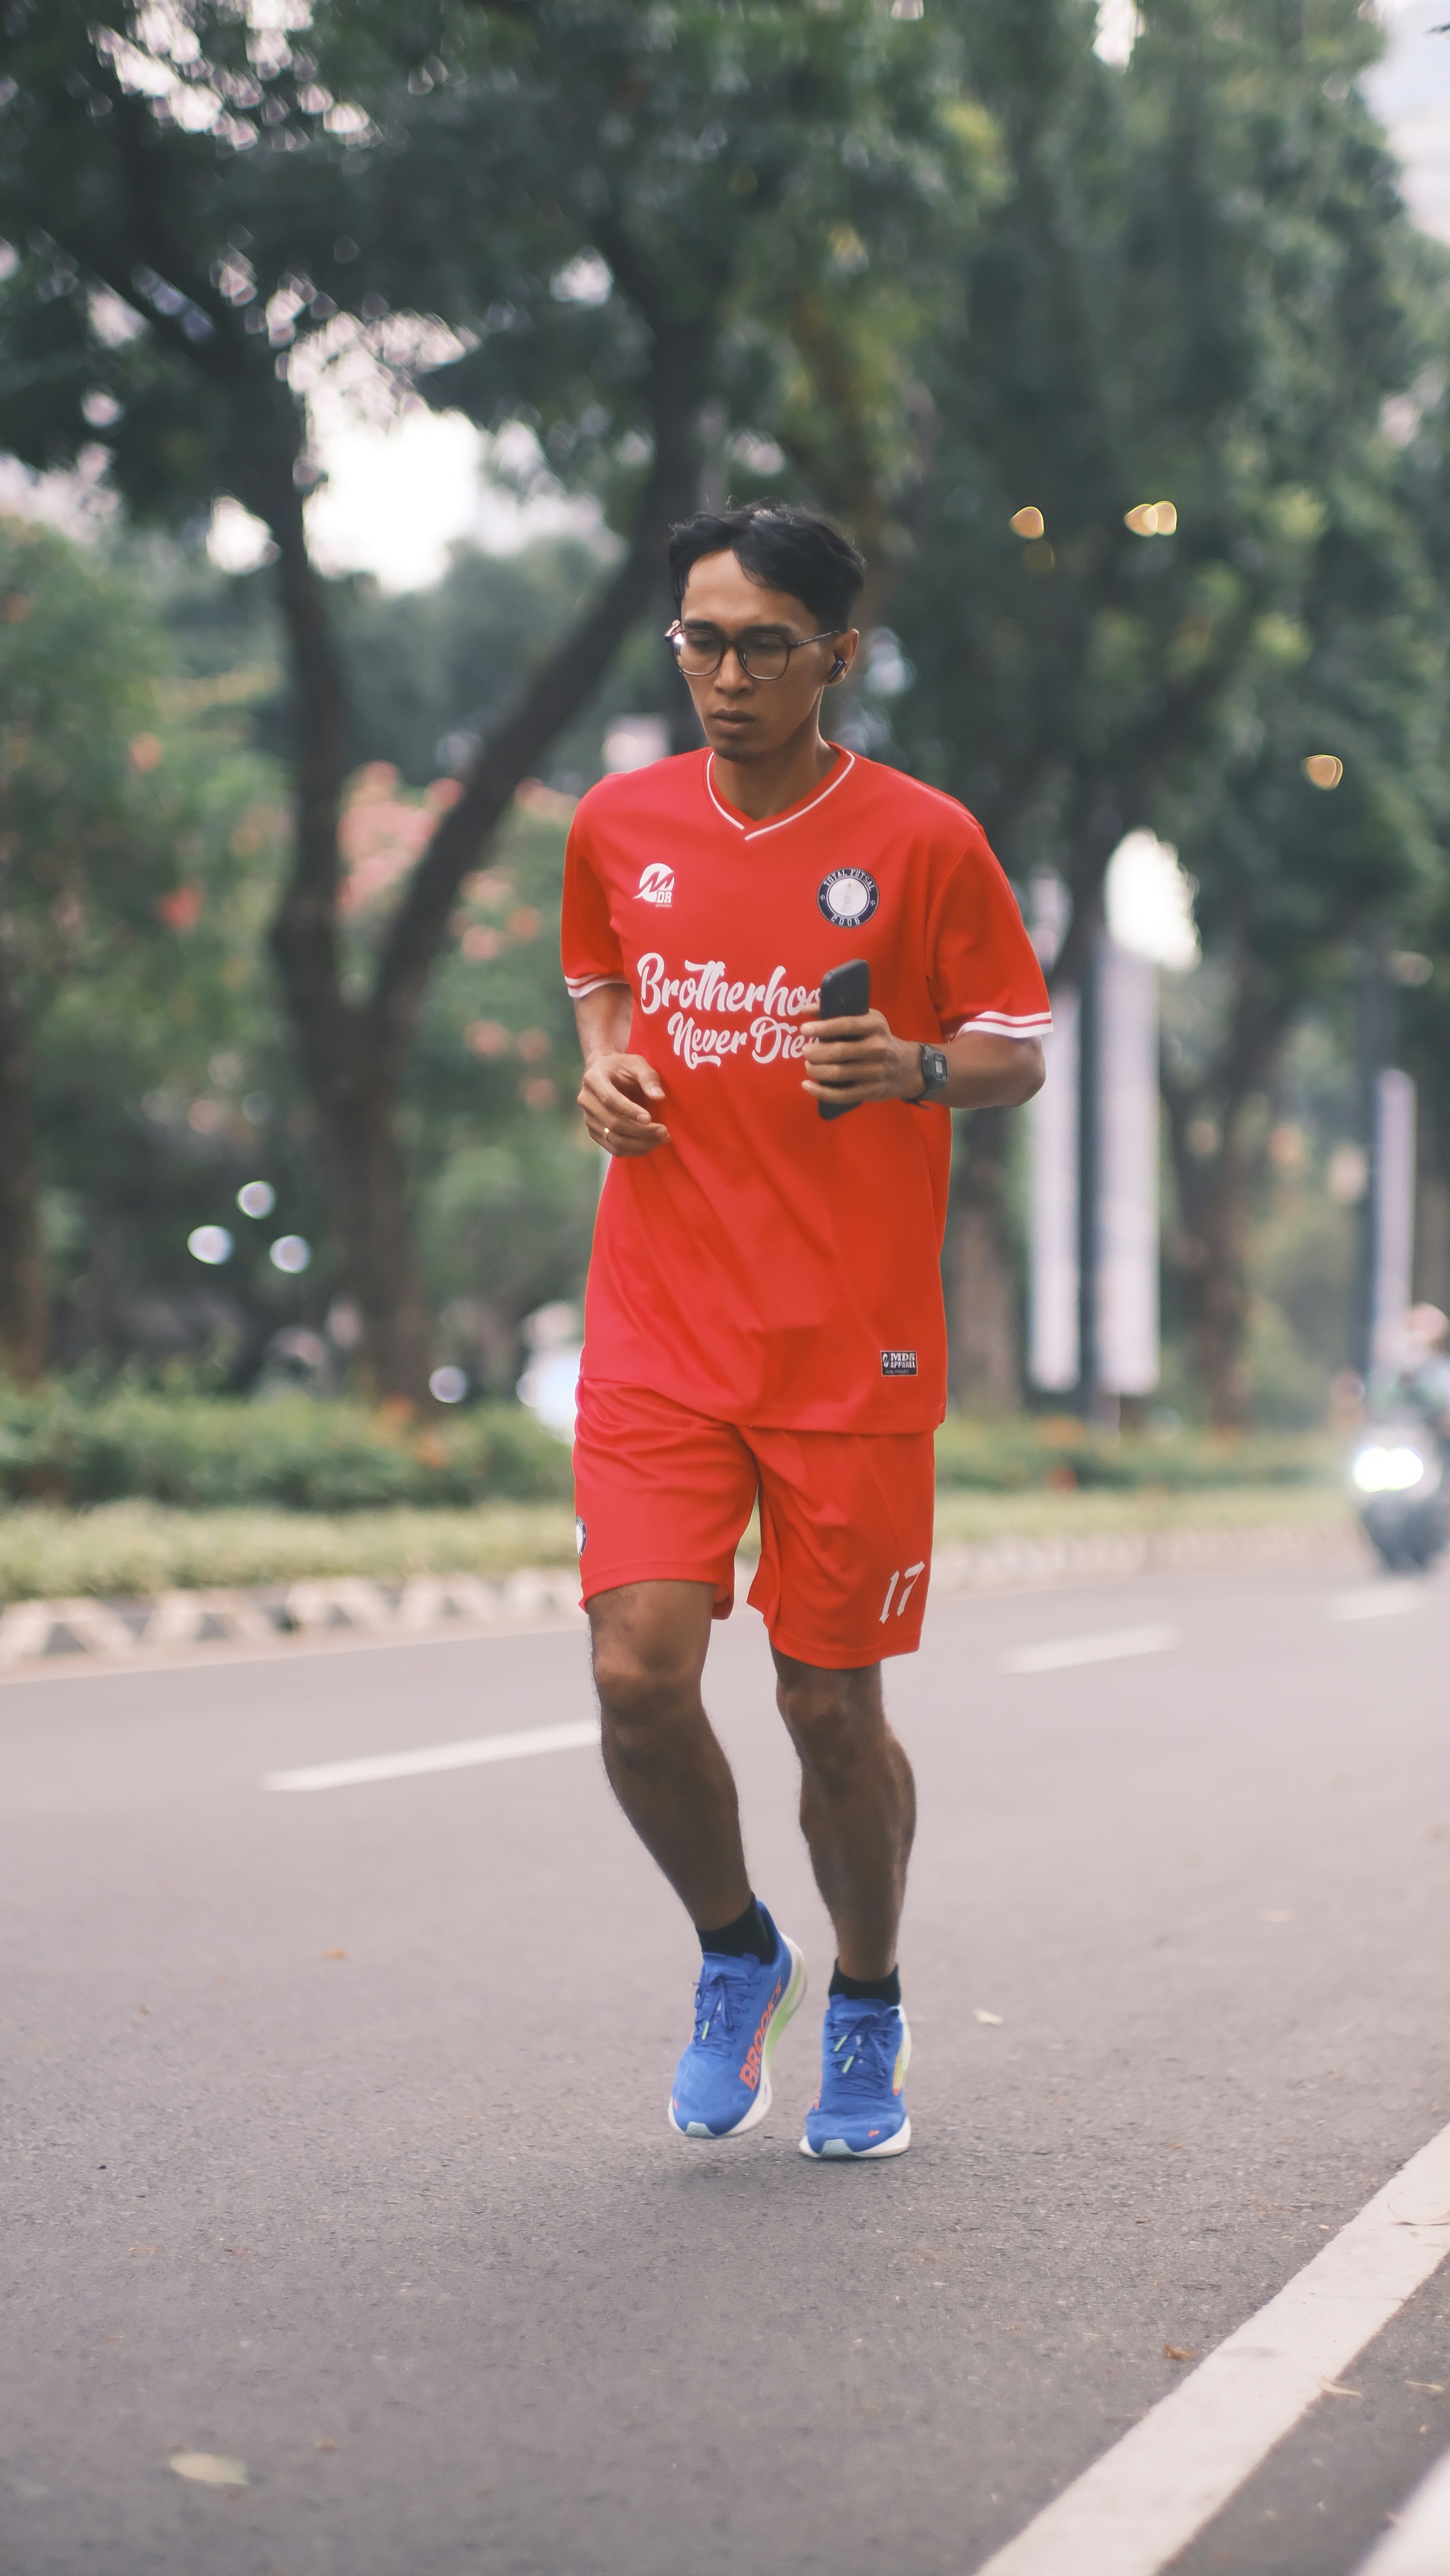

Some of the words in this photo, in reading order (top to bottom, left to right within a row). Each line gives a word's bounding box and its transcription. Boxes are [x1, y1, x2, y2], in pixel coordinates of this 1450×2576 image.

[824, 869, 847, 886] TOTAL
[851, 869, 874, 891] FUTSAL
[831, 914, 860, 926] 2006
[637, 952, 821, 1016] Brotherhoo
[667, 1011, 747, 1069] Never
[750, 1016, 819, 1063] Die
[891, 1353, 915, 1361] MDR
[879, 1560, 925, 1624] 17
